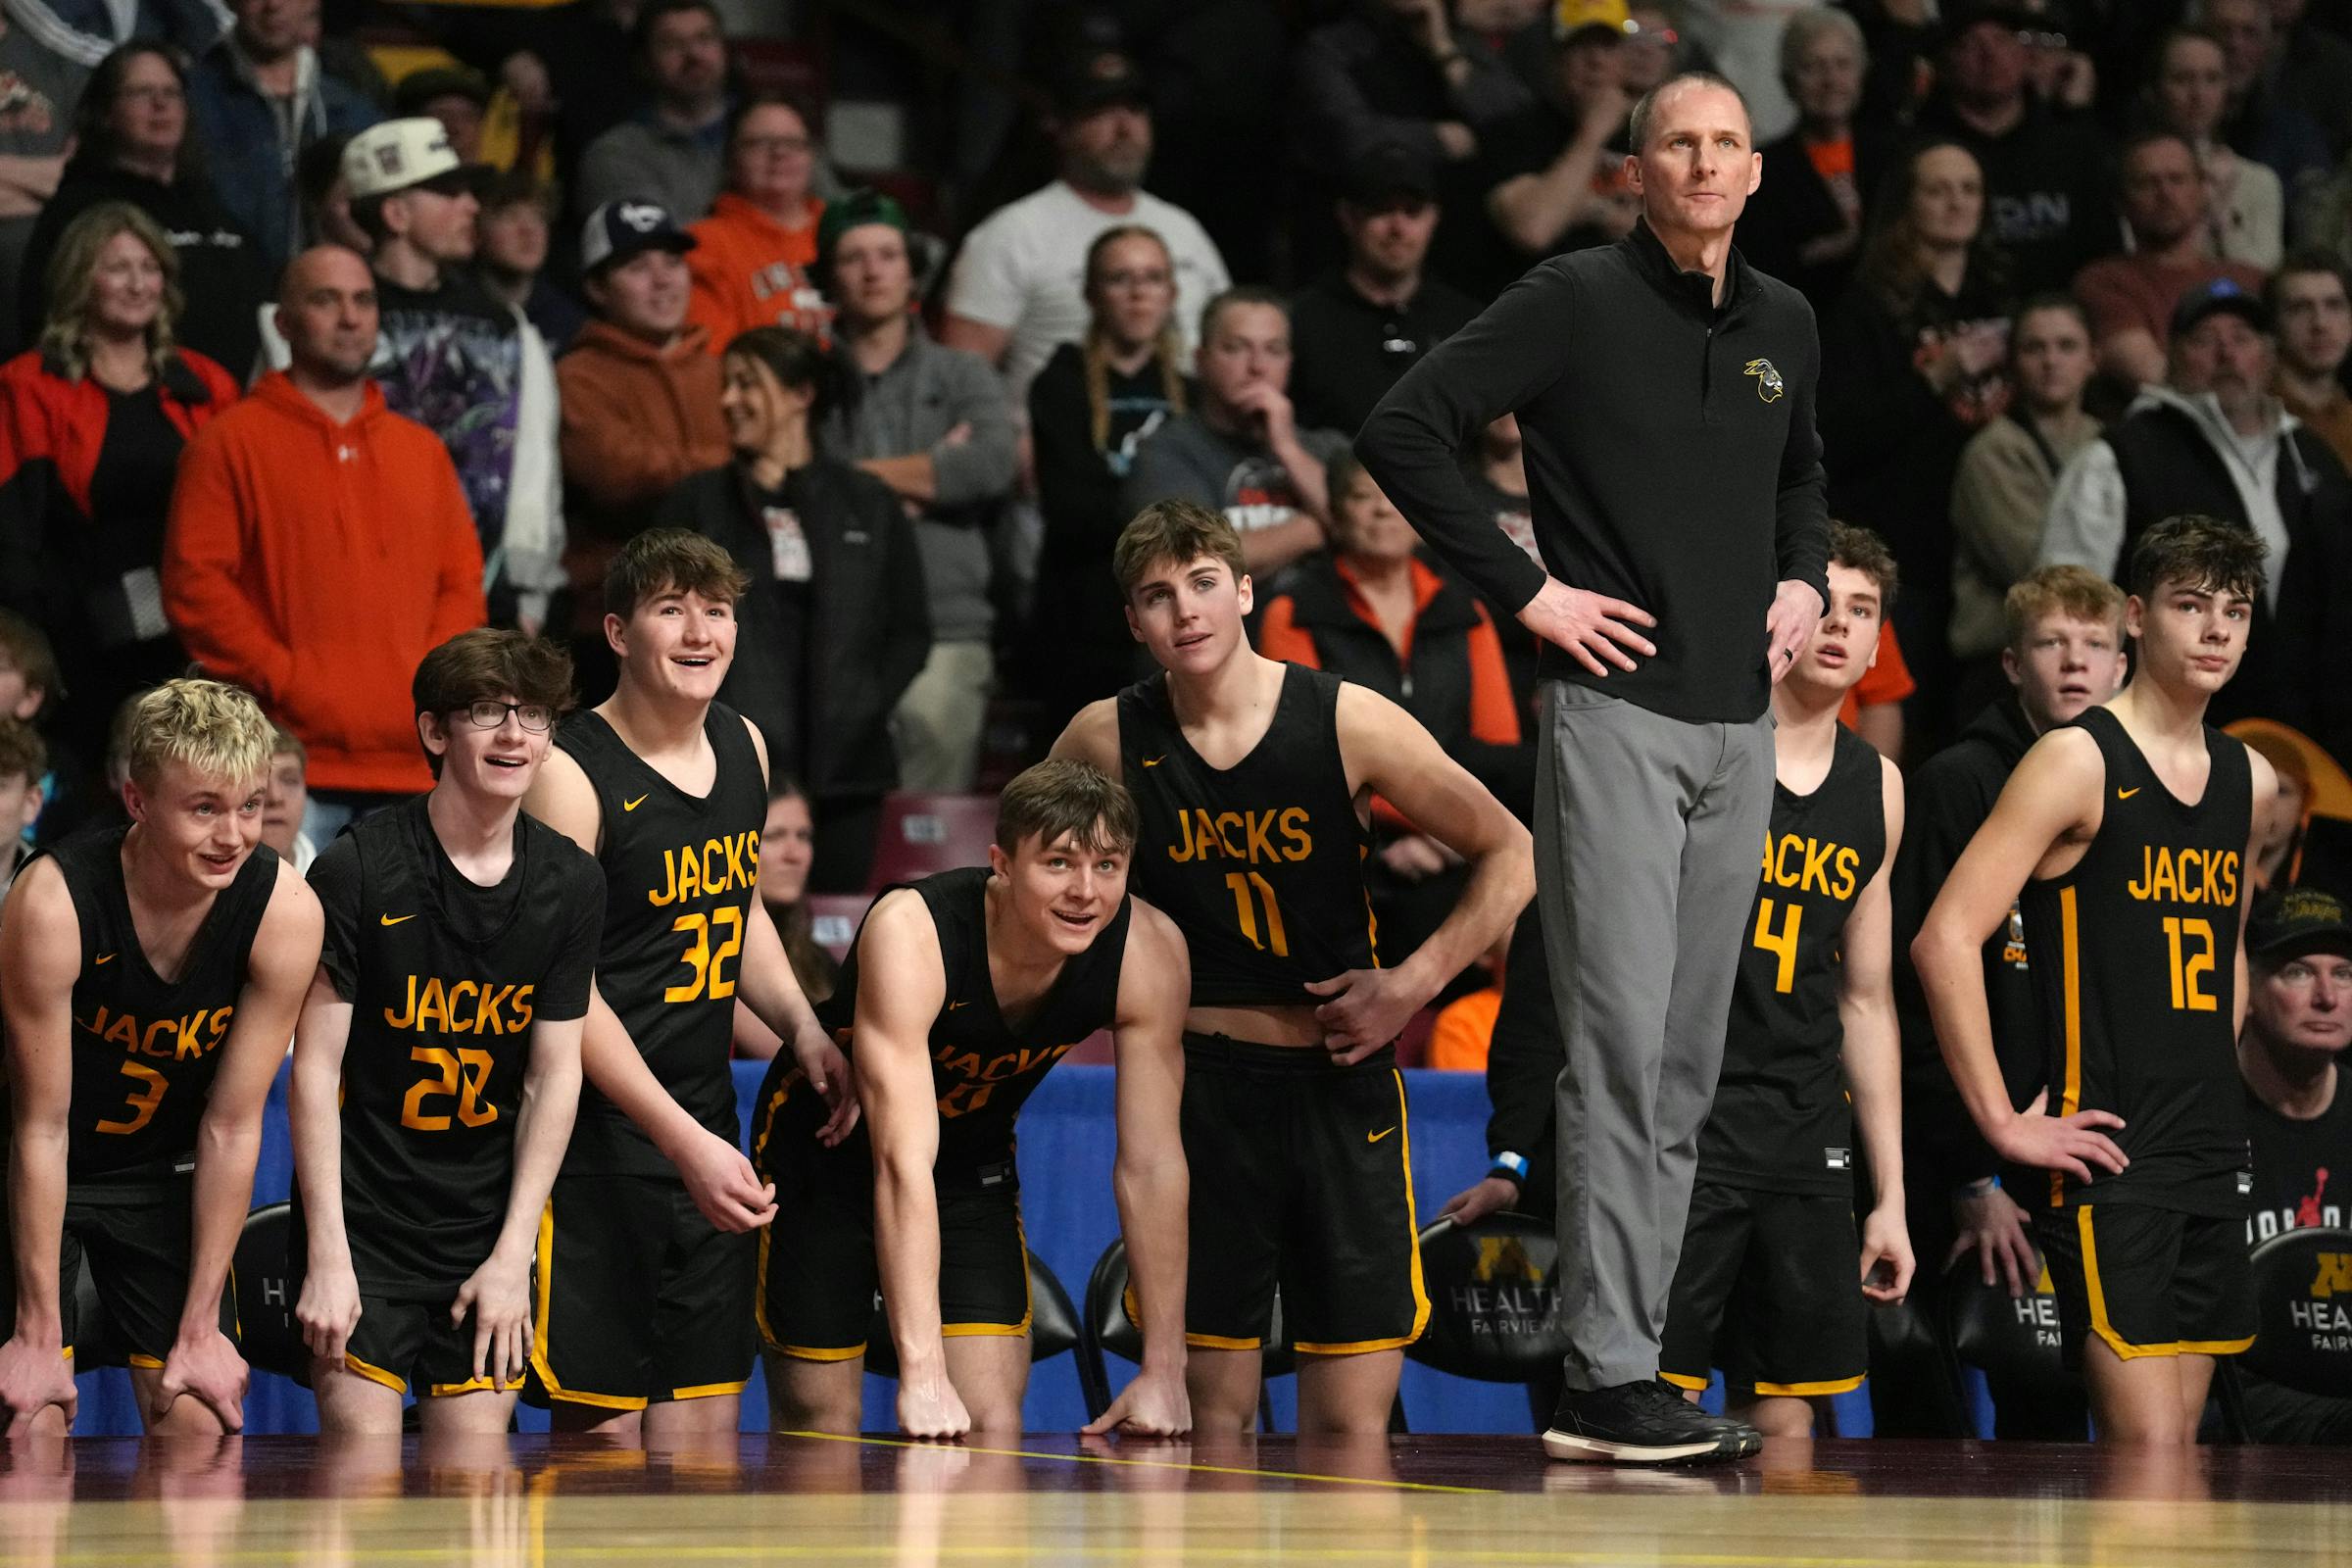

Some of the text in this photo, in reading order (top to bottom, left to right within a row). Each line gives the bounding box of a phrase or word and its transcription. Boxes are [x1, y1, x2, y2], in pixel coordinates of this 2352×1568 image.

[649, 830, 760, 906] JACKS
[1168, 807, 1313, 864] JACKS
[1762, 830, 1860, 901] ACKS
[2128, 846, 2239, 907] JACKS
[1225, 871, 1289, 956] 11
[1753, 897, 1803, 994] 4
[664, 906, 743, 1003] 32
[2163, 916, 2217, 1011] 12
[74, 1004, 233, 1061] JACKS
[384, 974, 534, 1036] JACKS
[95, 1059, 170, 1135] 3
[401, 1046, 498, 1131] 20
[2015, 1298, 2060, 1326] HE
[2311, 1333, 2352, 1350] FAIR
